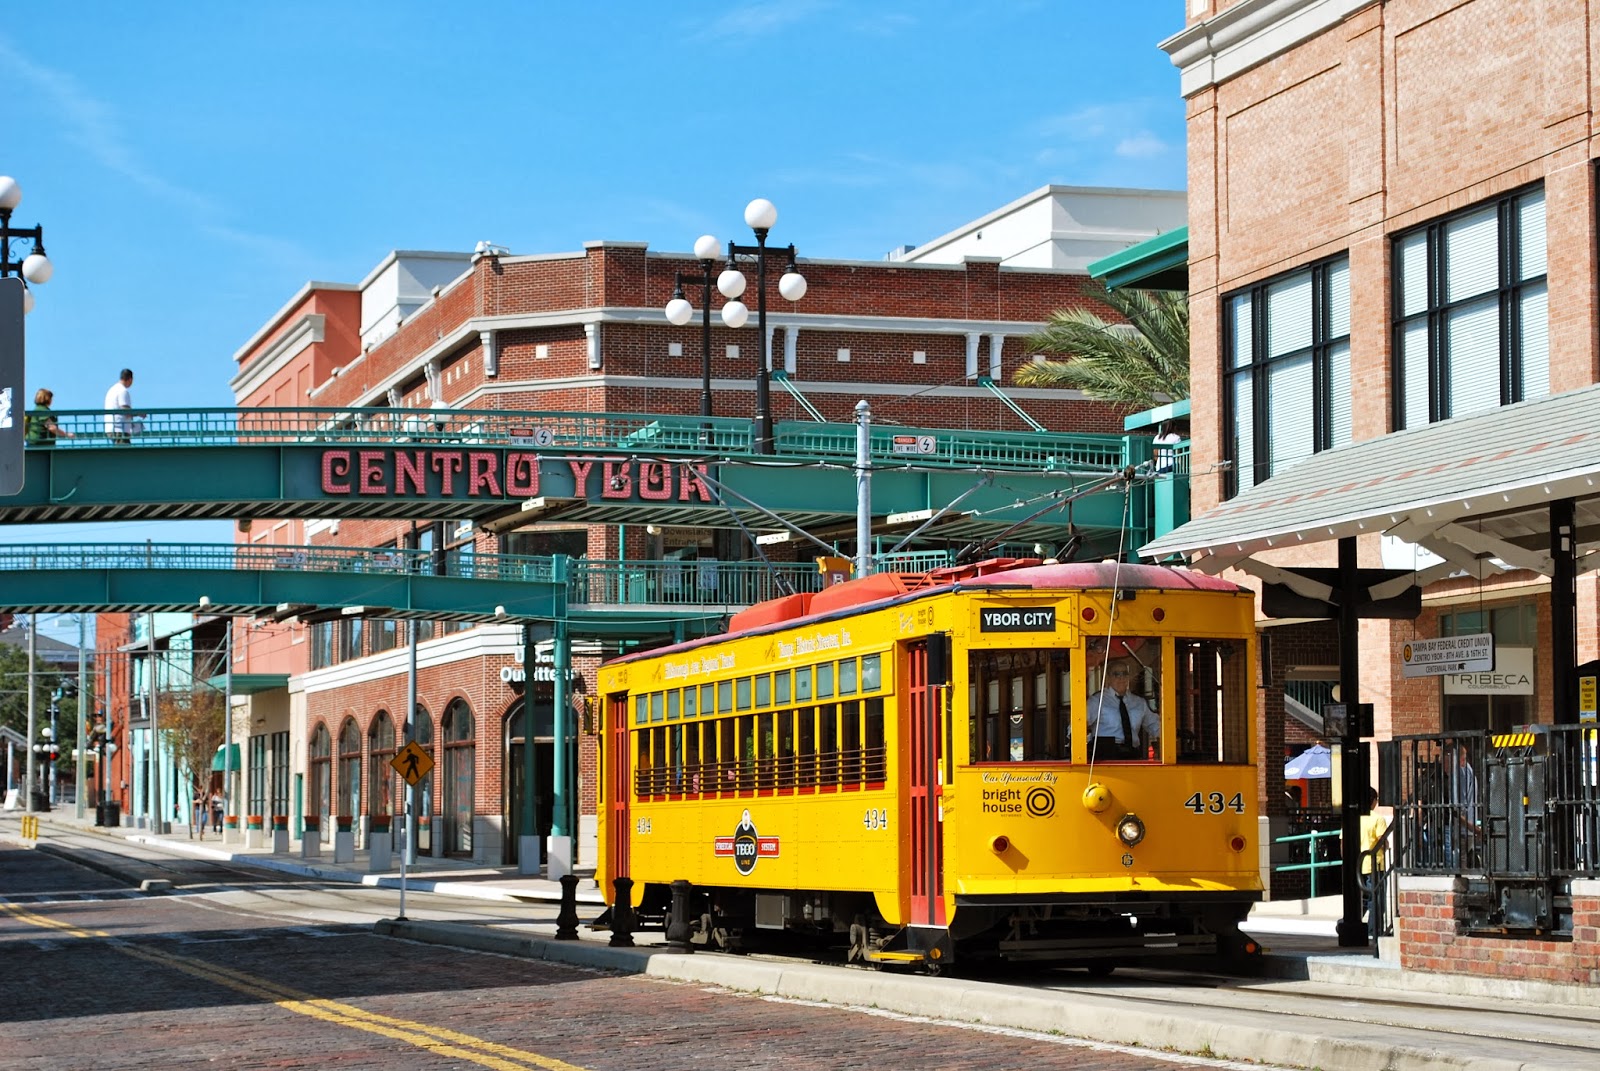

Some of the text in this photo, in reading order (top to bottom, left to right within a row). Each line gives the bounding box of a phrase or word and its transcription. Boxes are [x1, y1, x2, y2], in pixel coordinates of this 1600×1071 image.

[510, 437, 519, 445] LIVE
[322, 450, 711, 502] CENTRO YBOR
[984, 612, 1052, 626] YBOR CITY
[1413, 637, 1489, 652] TAMPA BAY FEDERAL CREDIT UNION
[1414, 653, 1430, 663] CENTRO
[1431, 652, 1442, 661] YBOR
[1446, 652, 1454, 660] 8TH
[1455, 651, 1465, 659] AVE.
[1470, 649, 1480, 658] 16TH
[1426, 663, 1457, 674] CENTENNIAL PARK
[1448, 674, 1530, 685] TRIBECA
[1000, 772, 1043, 786] Sponsored
[1043, 772, 1058, 786] By
[983, 789, 1021, 802] bright
[983, 802, 1022, 812] house
[1184, 792, 1246, 815] 434
[636, 816, 652, 834] 434
[863, 808, 888, 830] 434
[736, 843, 755, 856] TECO
